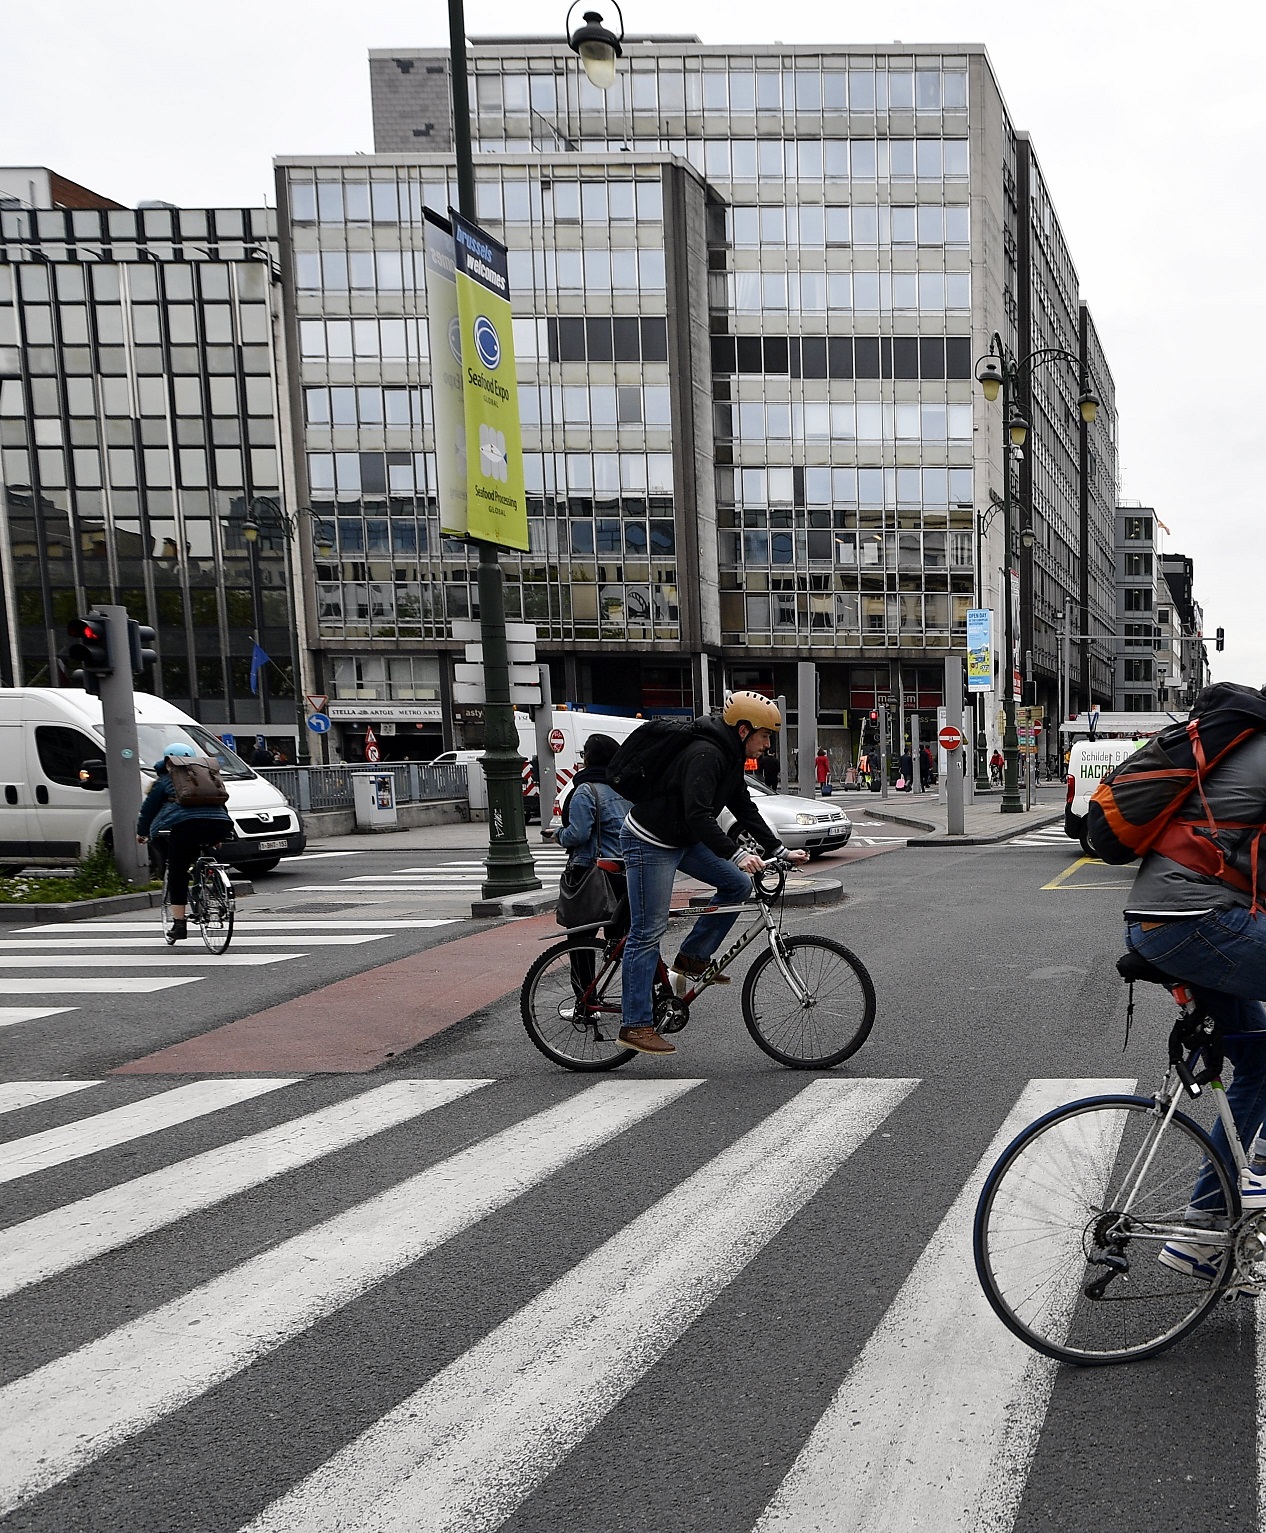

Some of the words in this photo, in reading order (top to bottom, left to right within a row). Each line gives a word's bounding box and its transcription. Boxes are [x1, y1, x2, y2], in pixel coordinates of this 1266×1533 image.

[456, 224, 493, 263] brussels
[466, 253, 506, 291] welcomes
[468, 367, 494, 394] Seafood
[494, 380, 510, 402] Expo
[483, 395, 499, 408] GLOBAL
[475, 484, 495, 501] Seafood
[495, 490, 518, 512] Processing
[488, 505, 506, 517] GLOBAL
[1081, 751, 1113, 762] Schilder
[1115, 751, 1121, 762] &
[702, 928, 751, 983] GIANT
